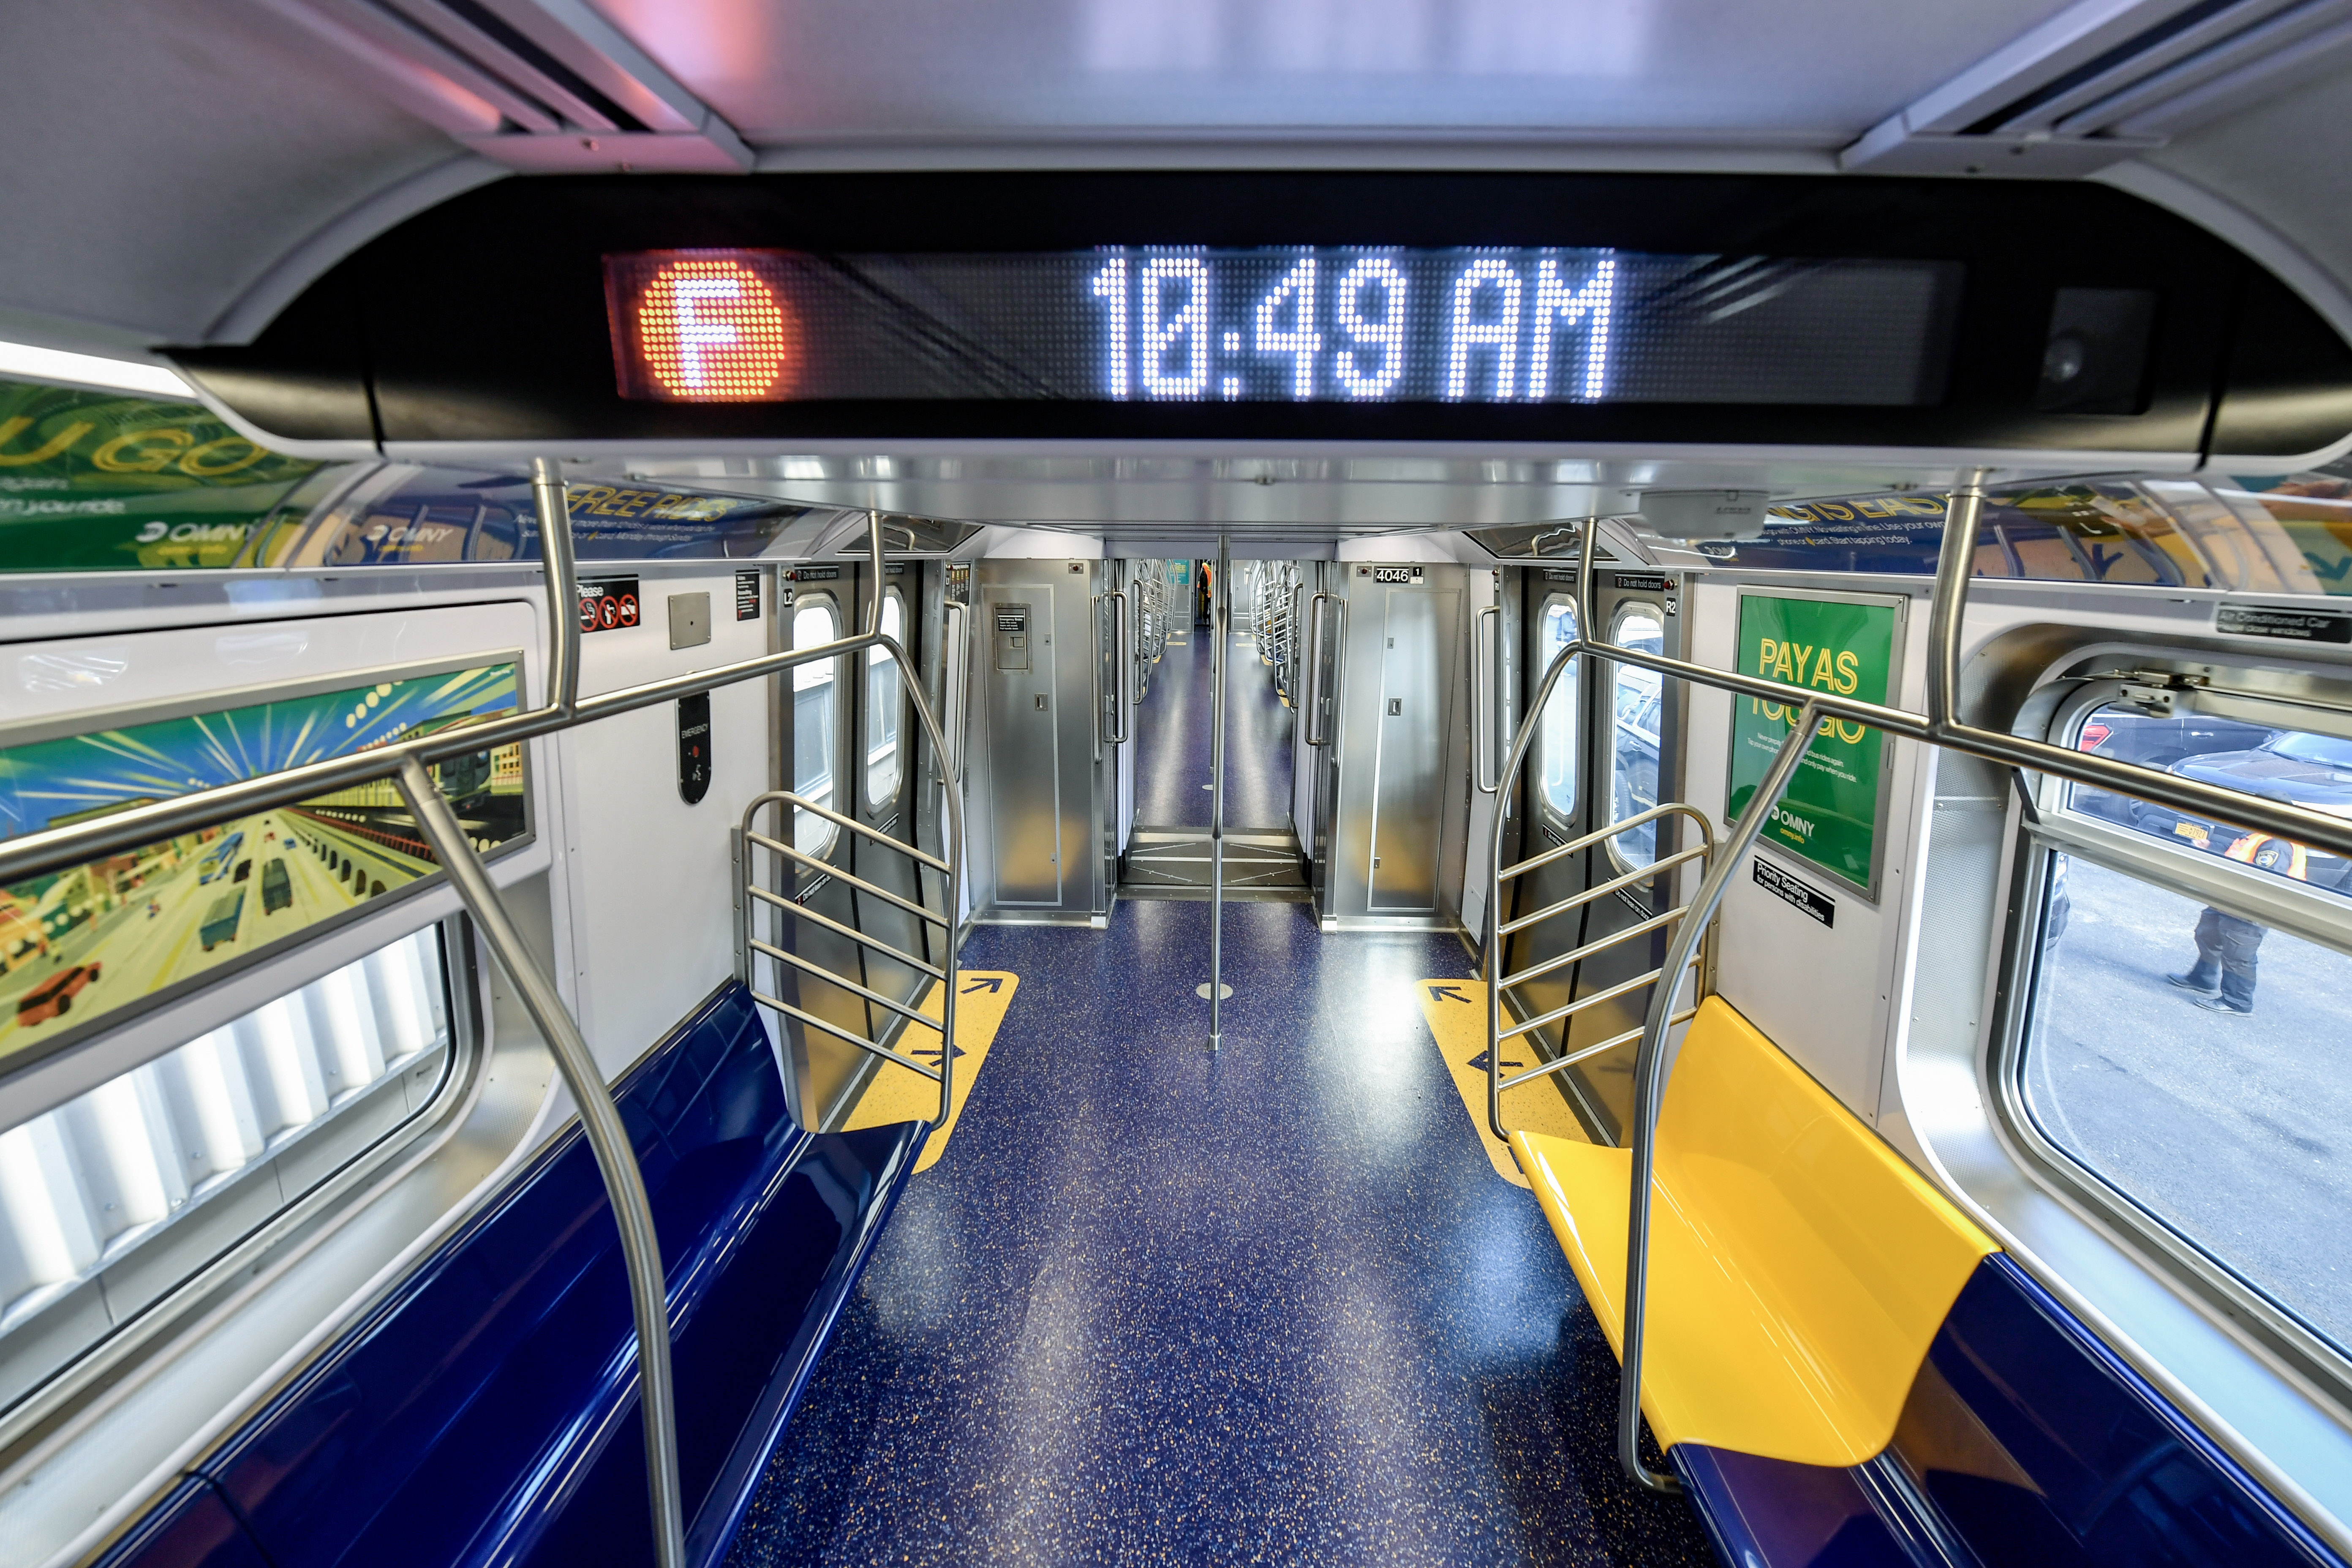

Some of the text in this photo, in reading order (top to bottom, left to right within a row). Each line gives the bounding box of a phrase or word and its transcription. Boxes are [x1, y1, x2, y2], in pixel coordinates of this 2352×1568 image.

[675, 258, 1615, 397] F 10:49 AM
[1879, 523, 1902, 531] Use
[1901, 522, 1924, 531] your
[1850, 535, 1886, 545] tapping
[1881, 534, 1913, 545] today.
[1377, 570, 1409, 582] 4046
[1416, 568, 1420, 576] 1
[576, 584, 604, 598] Please
[1623, 578, 1630, 587] Do
[1638, 578, 1647, 588] hold
[1648, 580, 1661, 589] doors
[784, 592, 793, 604] L2
[1666, 600, 1677, 613] R2
[2236, 612, 2306, 626] Conditioned
[2307, 616, 2332, 629] Car
[1759, 638, 1859, 695] PAY AS
[681, 723, 709, 739] EMERGENCY
[1780, 810, 1815, 837] OMNY
[1780, 828, 1805, 844] omny.info
[1757, 863, 1808, 903] Priority Seating
[1615, 889, 1621, 898] Do
[1627, 897, 1635, 909] lean
[1635, 906, 1640, 914] on
[1764, 880, 1784, 897] persons
[1784, 892, 1796, 904] with
[1796, 898, 1825, 922] disabilities
